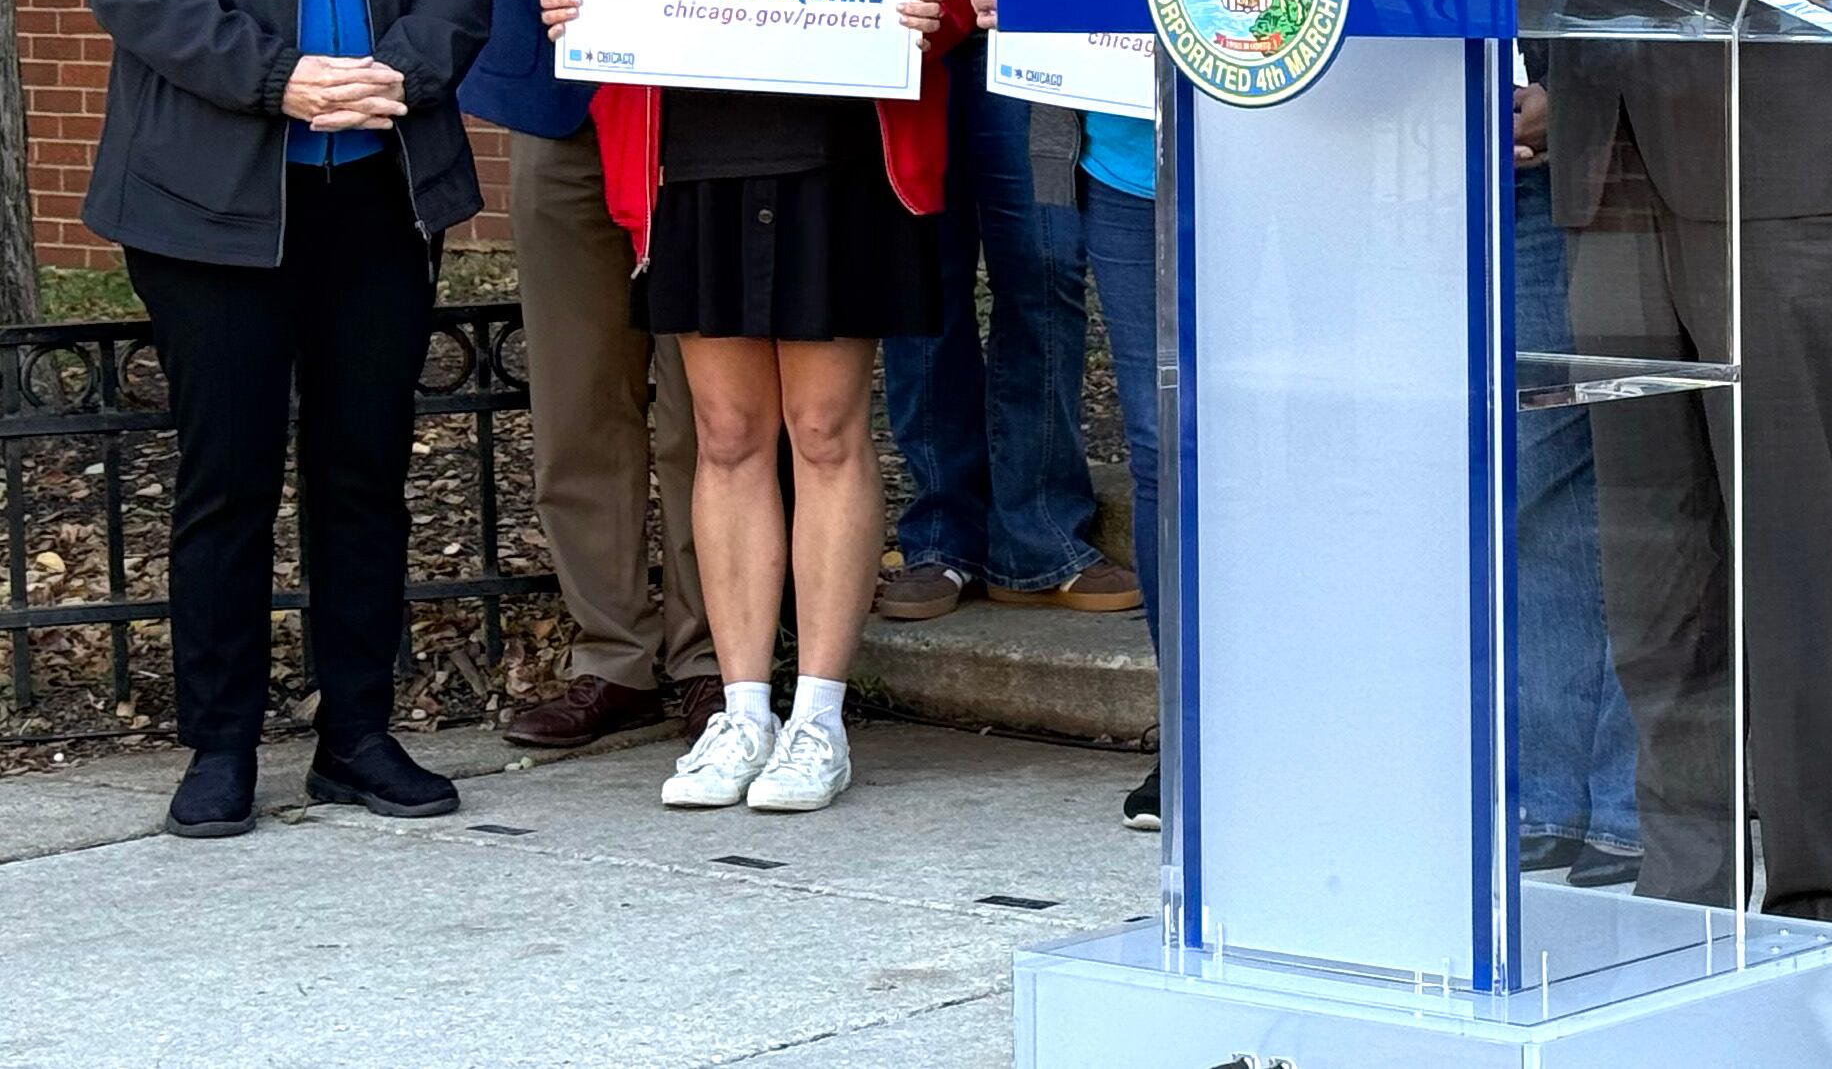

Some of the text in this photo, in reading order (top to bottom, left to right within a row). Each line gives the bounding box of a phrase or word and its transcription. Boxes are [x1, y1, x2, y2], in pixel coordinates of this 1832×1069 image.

[663, 0, 882, 30] chicago.gov/protect
[1088, 32, 1156, 58] chicag
[1025, 69, 1063, 87] CHICAGO
[1256, 64, 1286, 92] 4th
